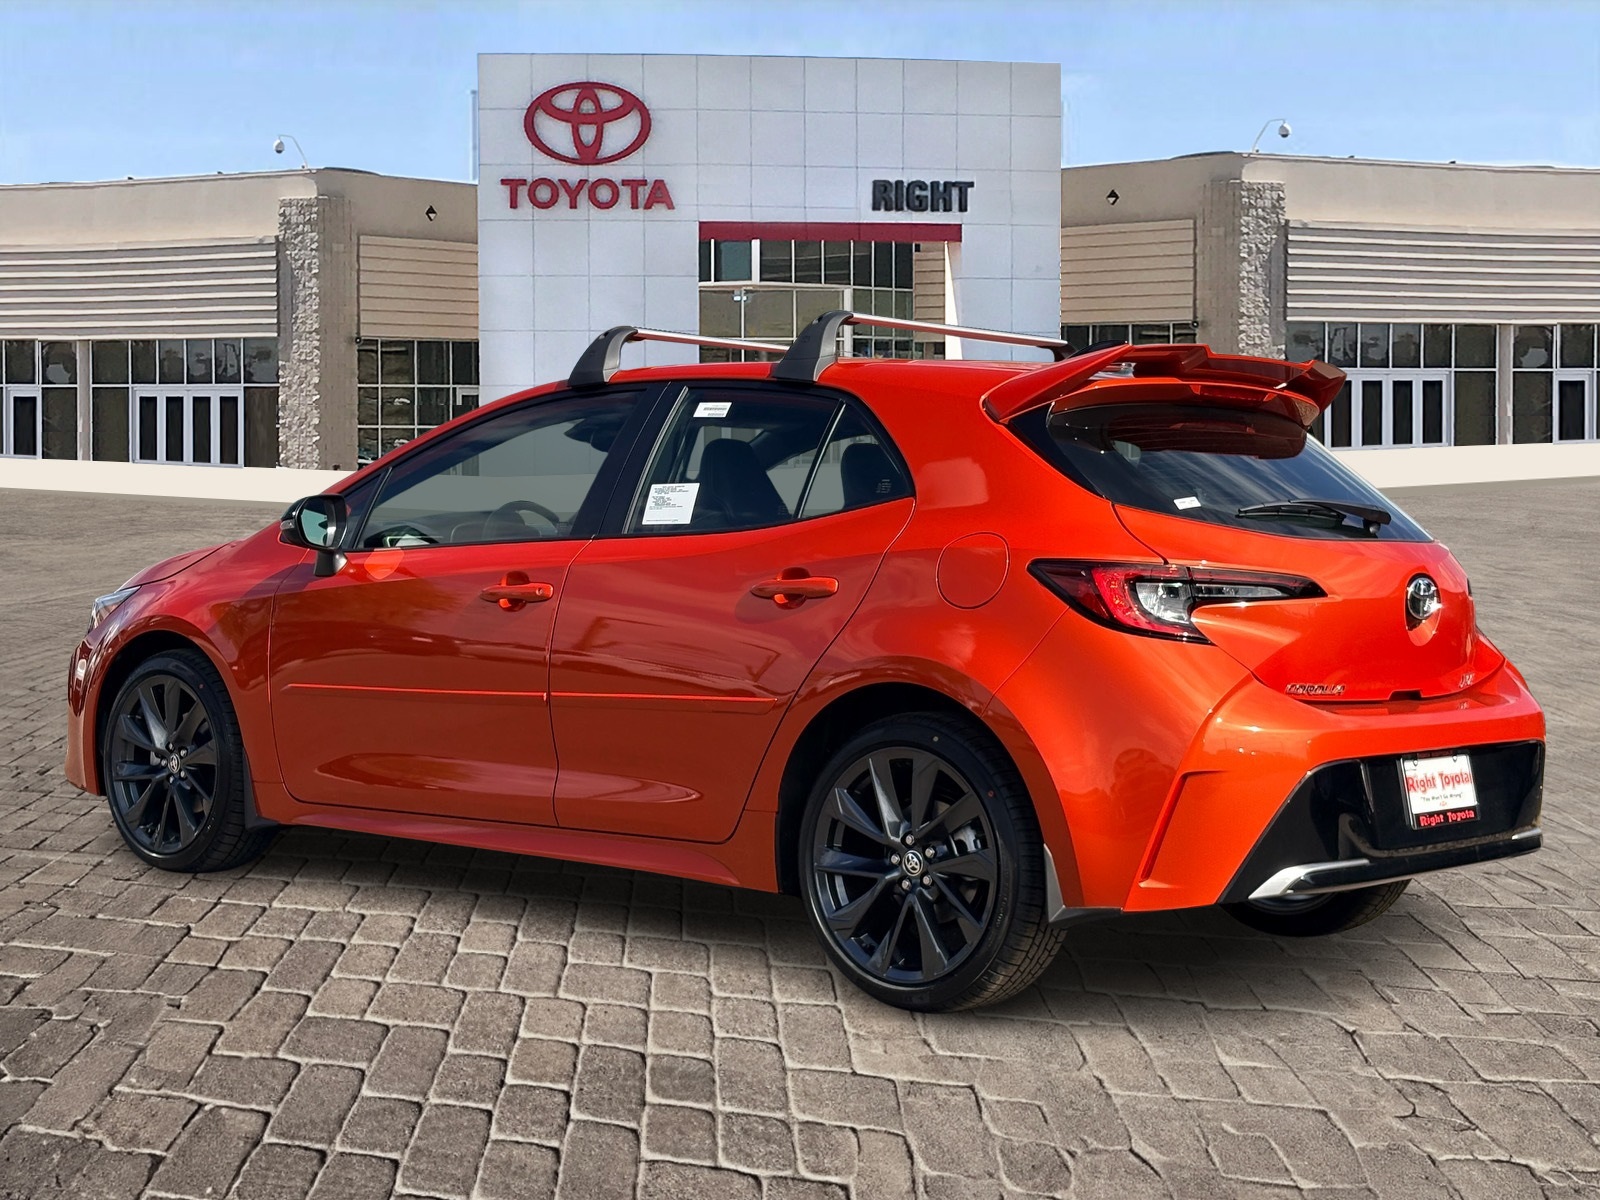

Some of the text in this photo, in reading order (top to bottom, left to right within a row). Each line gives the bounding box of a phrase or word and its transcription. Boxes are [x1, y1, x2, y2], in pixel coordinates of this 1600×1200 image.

[500, 178, 675, 211] TOYOTA
[872, 179, 975, 213] RIGHT
[1406, 770, 1471, 793] Right Toyota
[1419, 809, 1475, 827] Right Toyota
